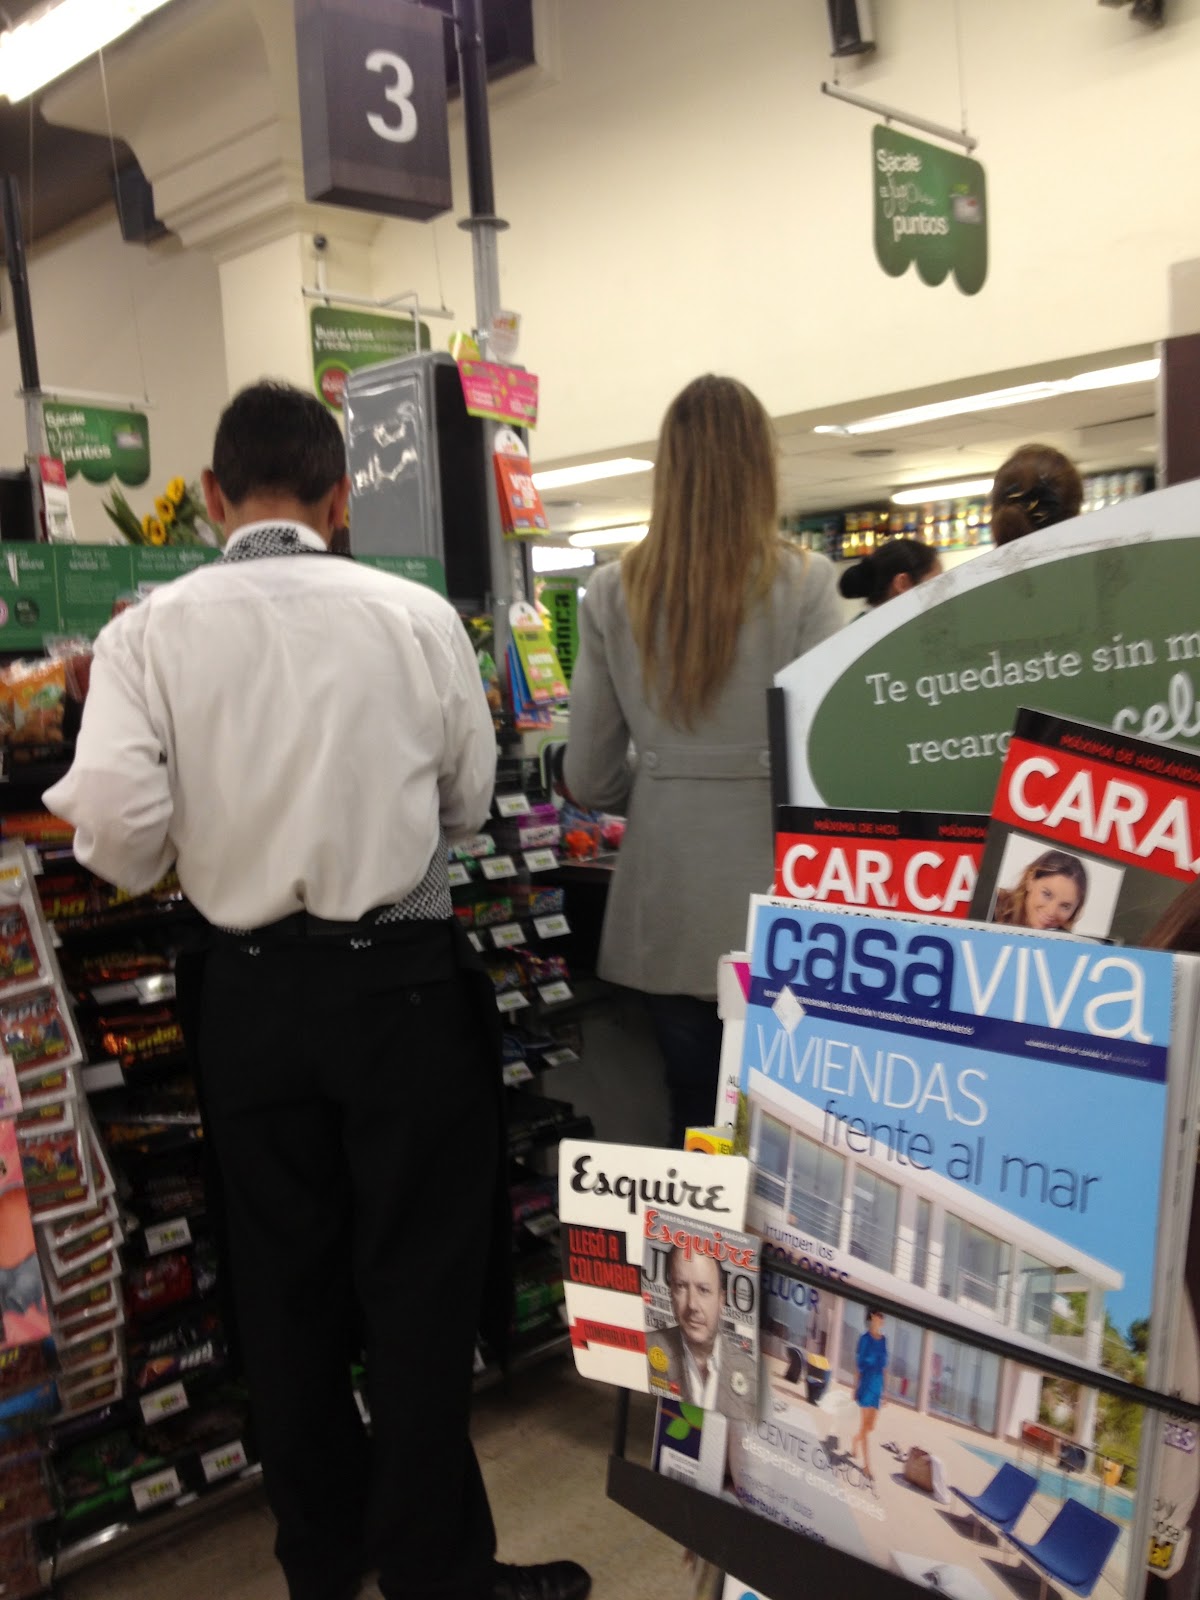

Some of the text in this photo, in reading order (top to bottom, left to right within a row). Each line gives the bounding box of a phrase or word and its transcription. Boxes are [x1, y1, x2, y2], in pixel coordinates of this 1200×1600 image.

[365, 49, 418, 143] 3
[893, 214, 949, 242] puntos
[866, 672, 908, 706] Te
[916, 650, 1081, 706] quedaste
[1092, 634, 1157, 672] sin
[1008, 756, 1200, 875] CARA
[782, 844, 899, 908] CAR
[757, 1024, 989, 1127] VIVIENDAS
[570, 1155, 731, 1214] Esquire
[822, 1099, 1102, 1213] frente al mar
[569, 1255, 640, 1294] COLOMBIA
[644, 1209, 760, 1272] Esquire
